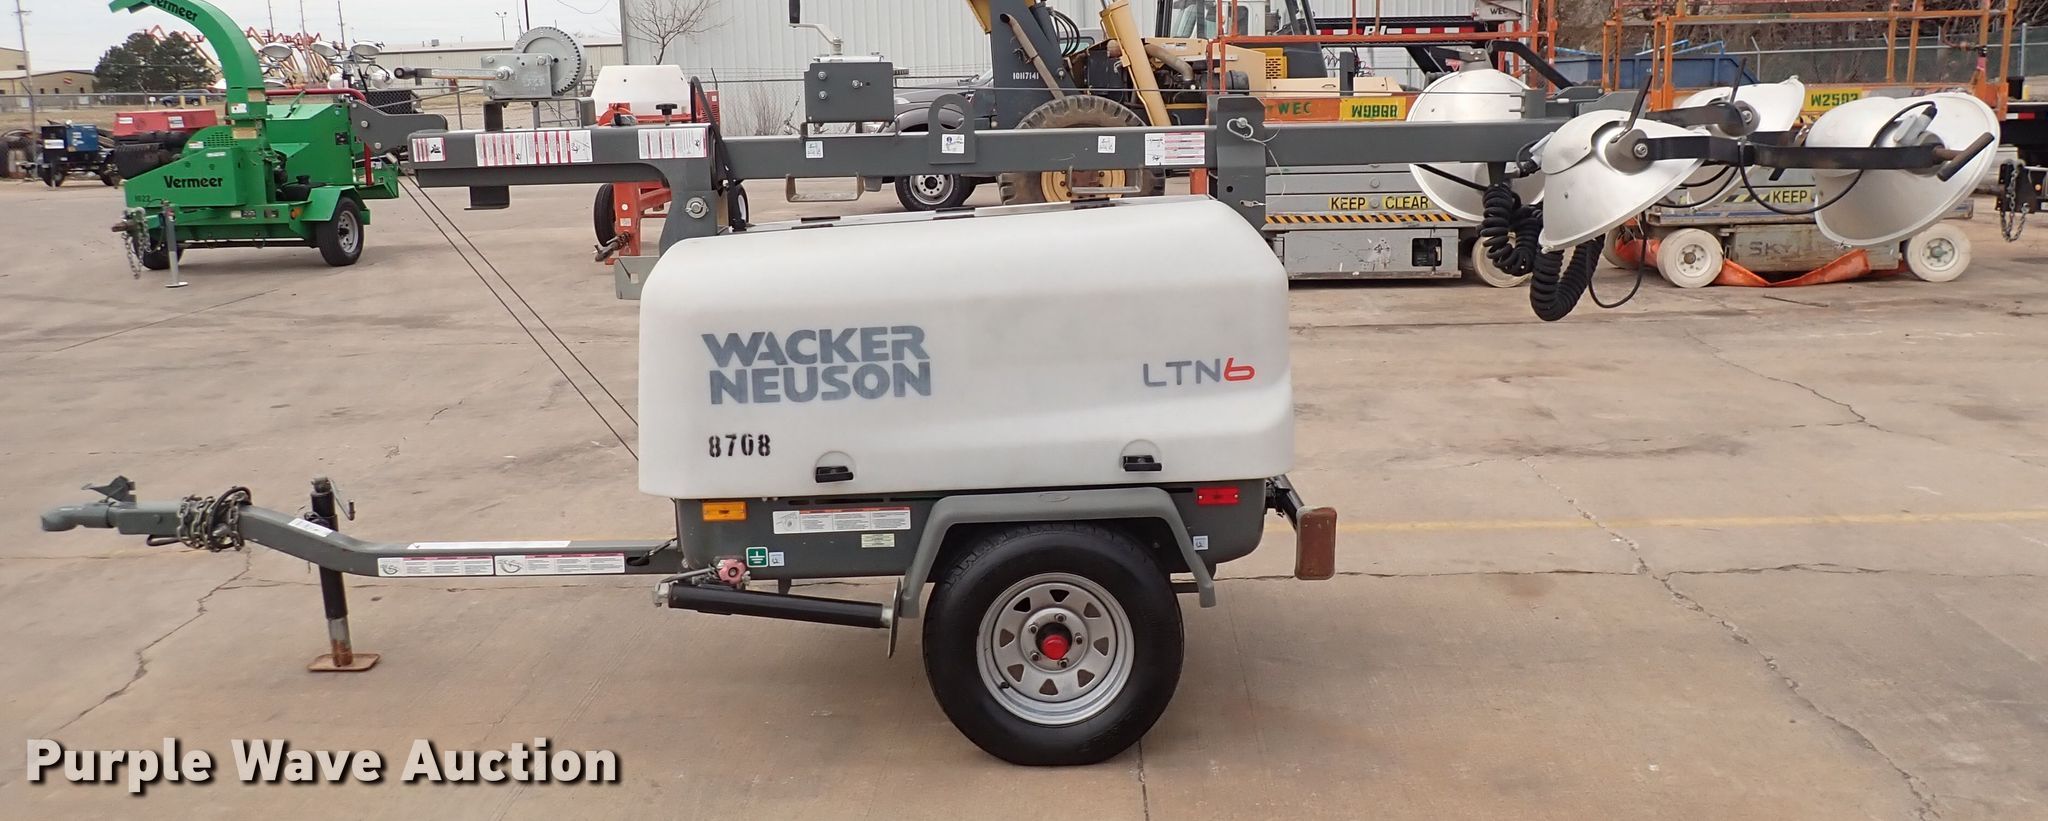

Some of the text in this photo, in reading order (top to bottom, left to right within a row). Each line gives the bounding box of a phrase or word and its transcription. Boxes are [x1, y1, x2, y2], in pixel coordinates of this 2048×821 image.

[1278, 101, 1312, 115] WEC
[163, 175, 223, 189] Vermeer
[1331, 196, 1429, 210] KEEP CLEAR
[1773, 190, 1808, 204] KEEP
[701, 325, 931, 368] WACKER
[1142, 357, 1256, 388] LTN6
[709, 361, 932, 405] NEUSON
[708, 433, 772, 458] 8708
